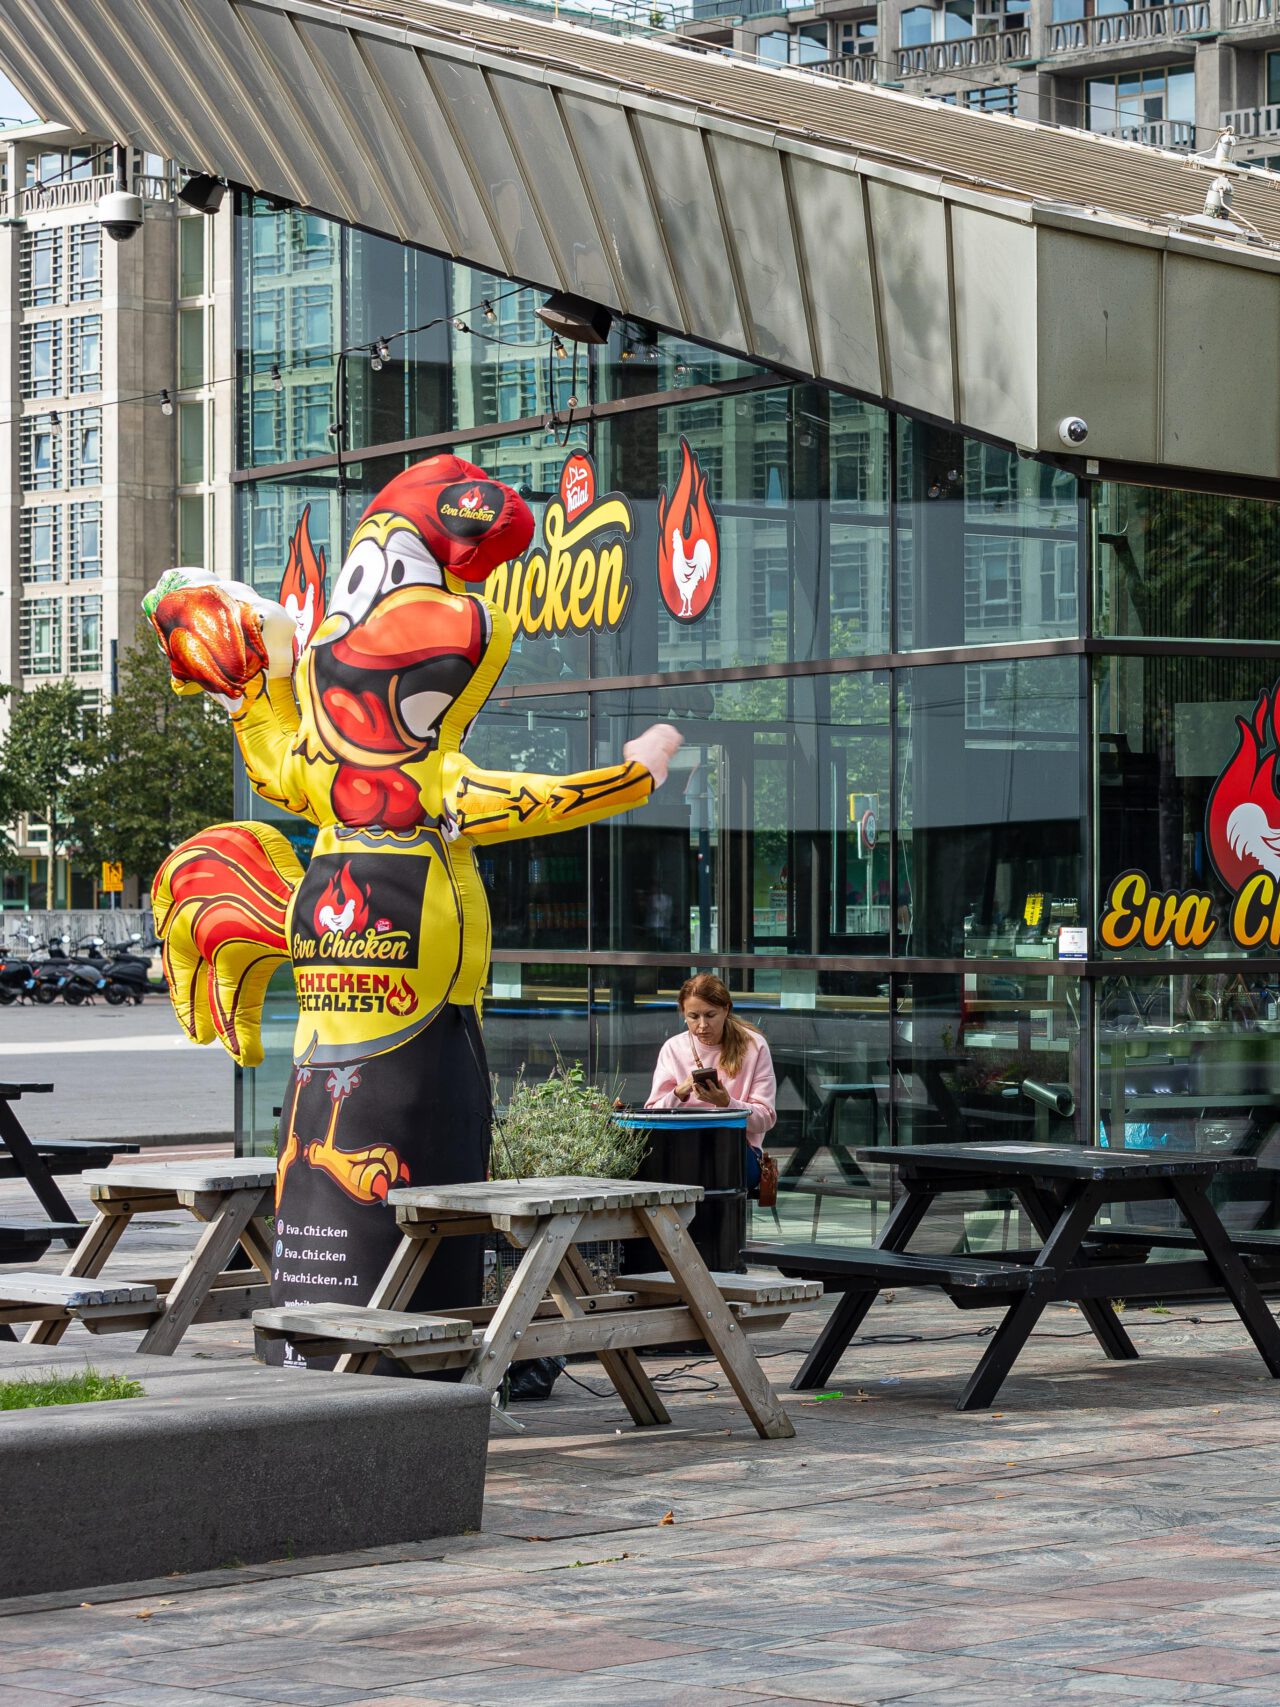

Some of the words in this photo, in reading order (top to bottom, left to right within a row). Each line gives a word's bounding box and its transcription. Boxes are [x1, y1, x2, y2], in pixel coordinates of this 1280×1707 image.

[565, 465, 588, 489] حلال
[440, 503, 459, 517] Eva
[458, 507, 496, 522] Chicken
[484, 500, 631, 634] hicken
[1101, 873, 1216, 947] Eva
[293, 932, 317, 960] Eva
[318, 928, 411, 960] Chicken
[299, 973, 390, 994] CHICKEN
[285, 1224, 349, 1238] Eva.Chicken
[283, 1248, 347, 1262] Eva.Chicken
[282, 1271, 360, 1287] Evachicken.nl
